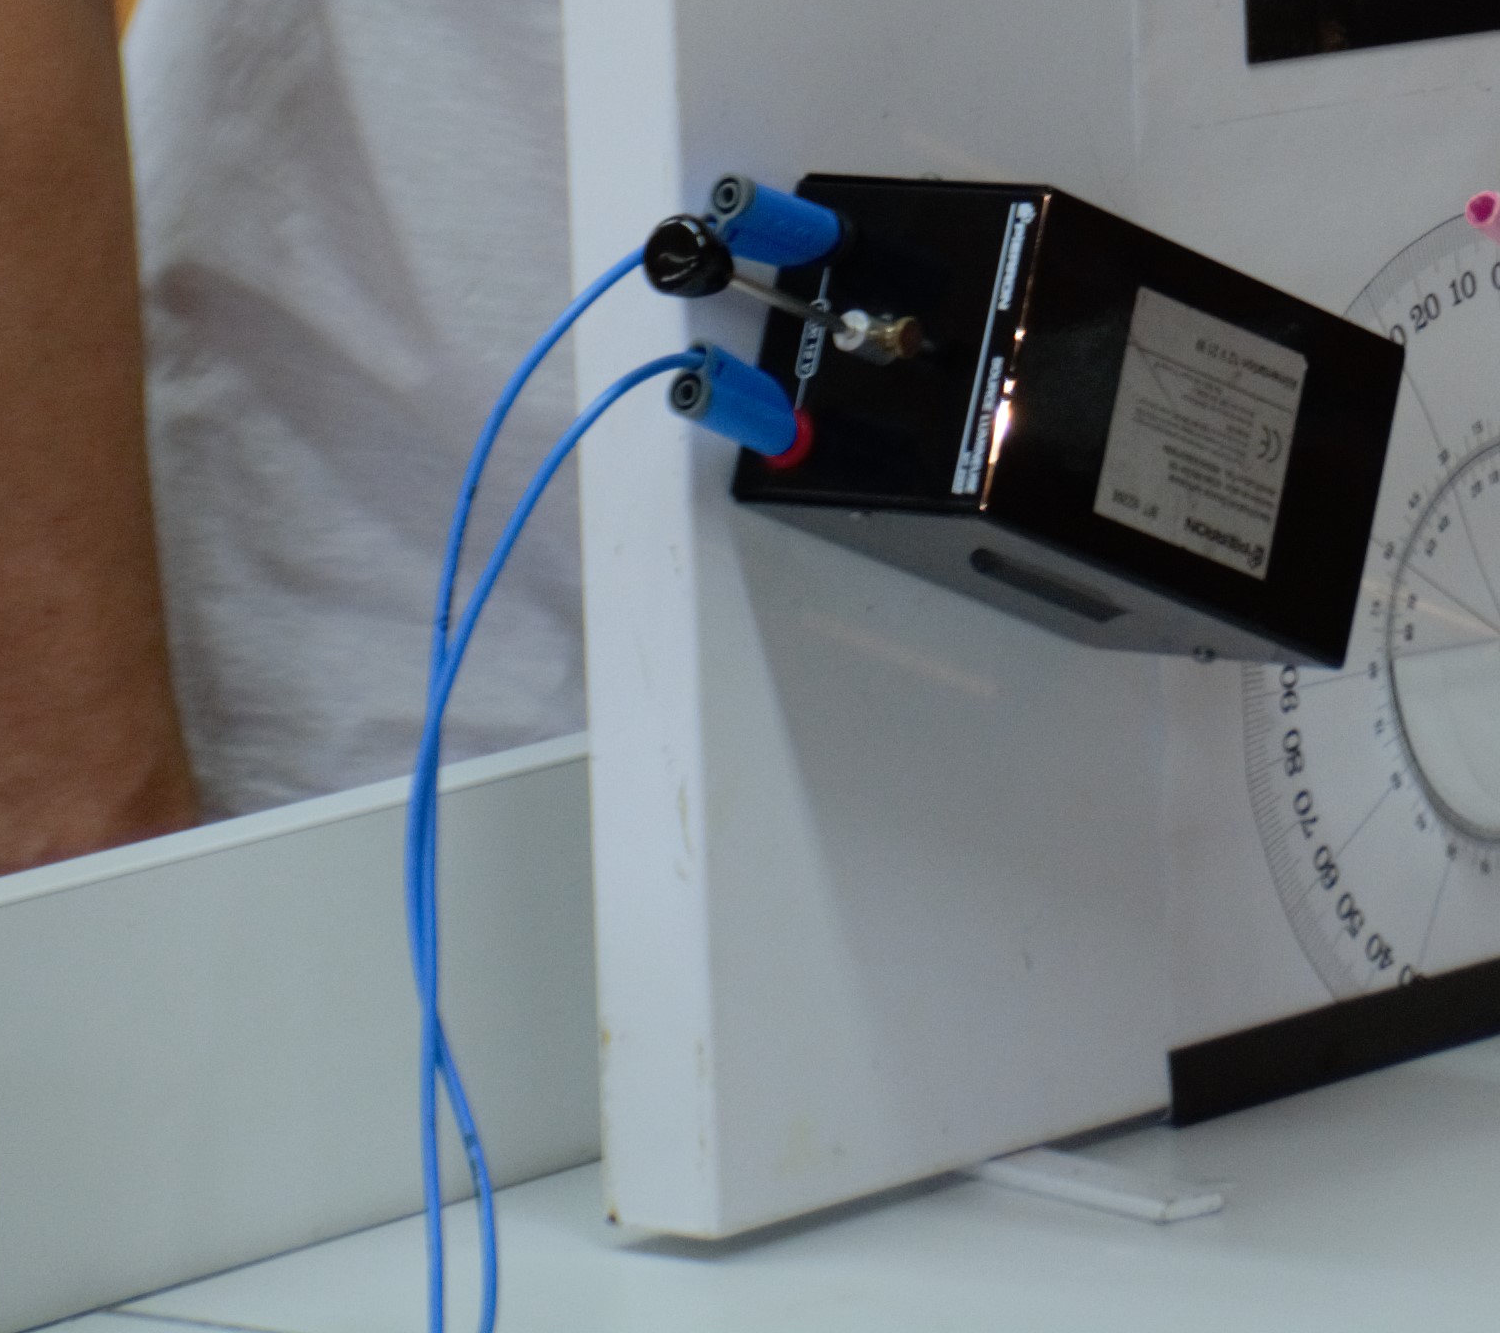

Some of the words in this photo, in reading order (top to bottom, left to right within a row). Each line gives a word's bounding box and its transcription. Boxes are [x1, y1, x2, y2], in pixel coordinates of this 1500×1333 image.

[998, 221, 1028, 310] PIERRON
[1449, 270, 1477, 308] 10
[1409, 293, 1441, 334] 20
[1279, 664, 1299, 714] 90
[1282, 728, 1305, 777] 80
[1293, 788, 1319, 839] 70
[1313, 844, 1340, 891] 60
[1336, 891, 1365, 939] 50
[1365, 933, 1395, 971] 40
